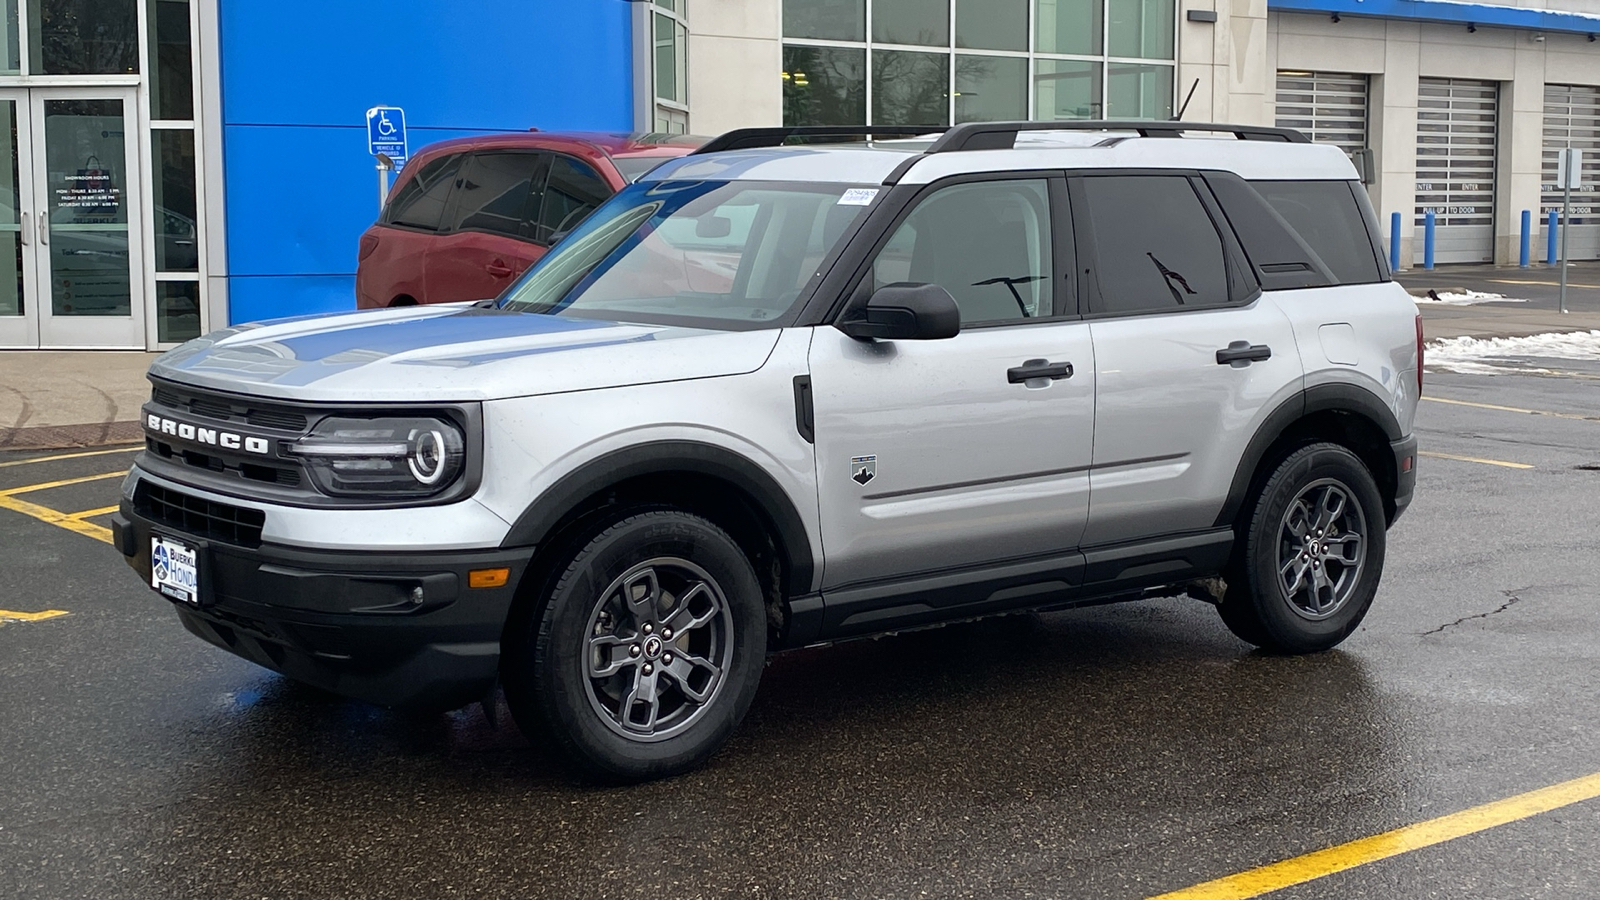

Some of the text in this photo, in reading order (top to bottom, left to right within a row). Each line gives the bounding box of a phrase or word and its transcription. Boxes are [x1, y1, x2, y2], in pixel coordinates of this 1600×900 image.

[1415, 183, 1432, 191] ENTER
[1462, 183, 1479, 191] ENTER
[148, 414, 268, 454] BRONCO
[170, 547, 196, 568] BUERKL
[170, 561, 197, 588] HONDA
